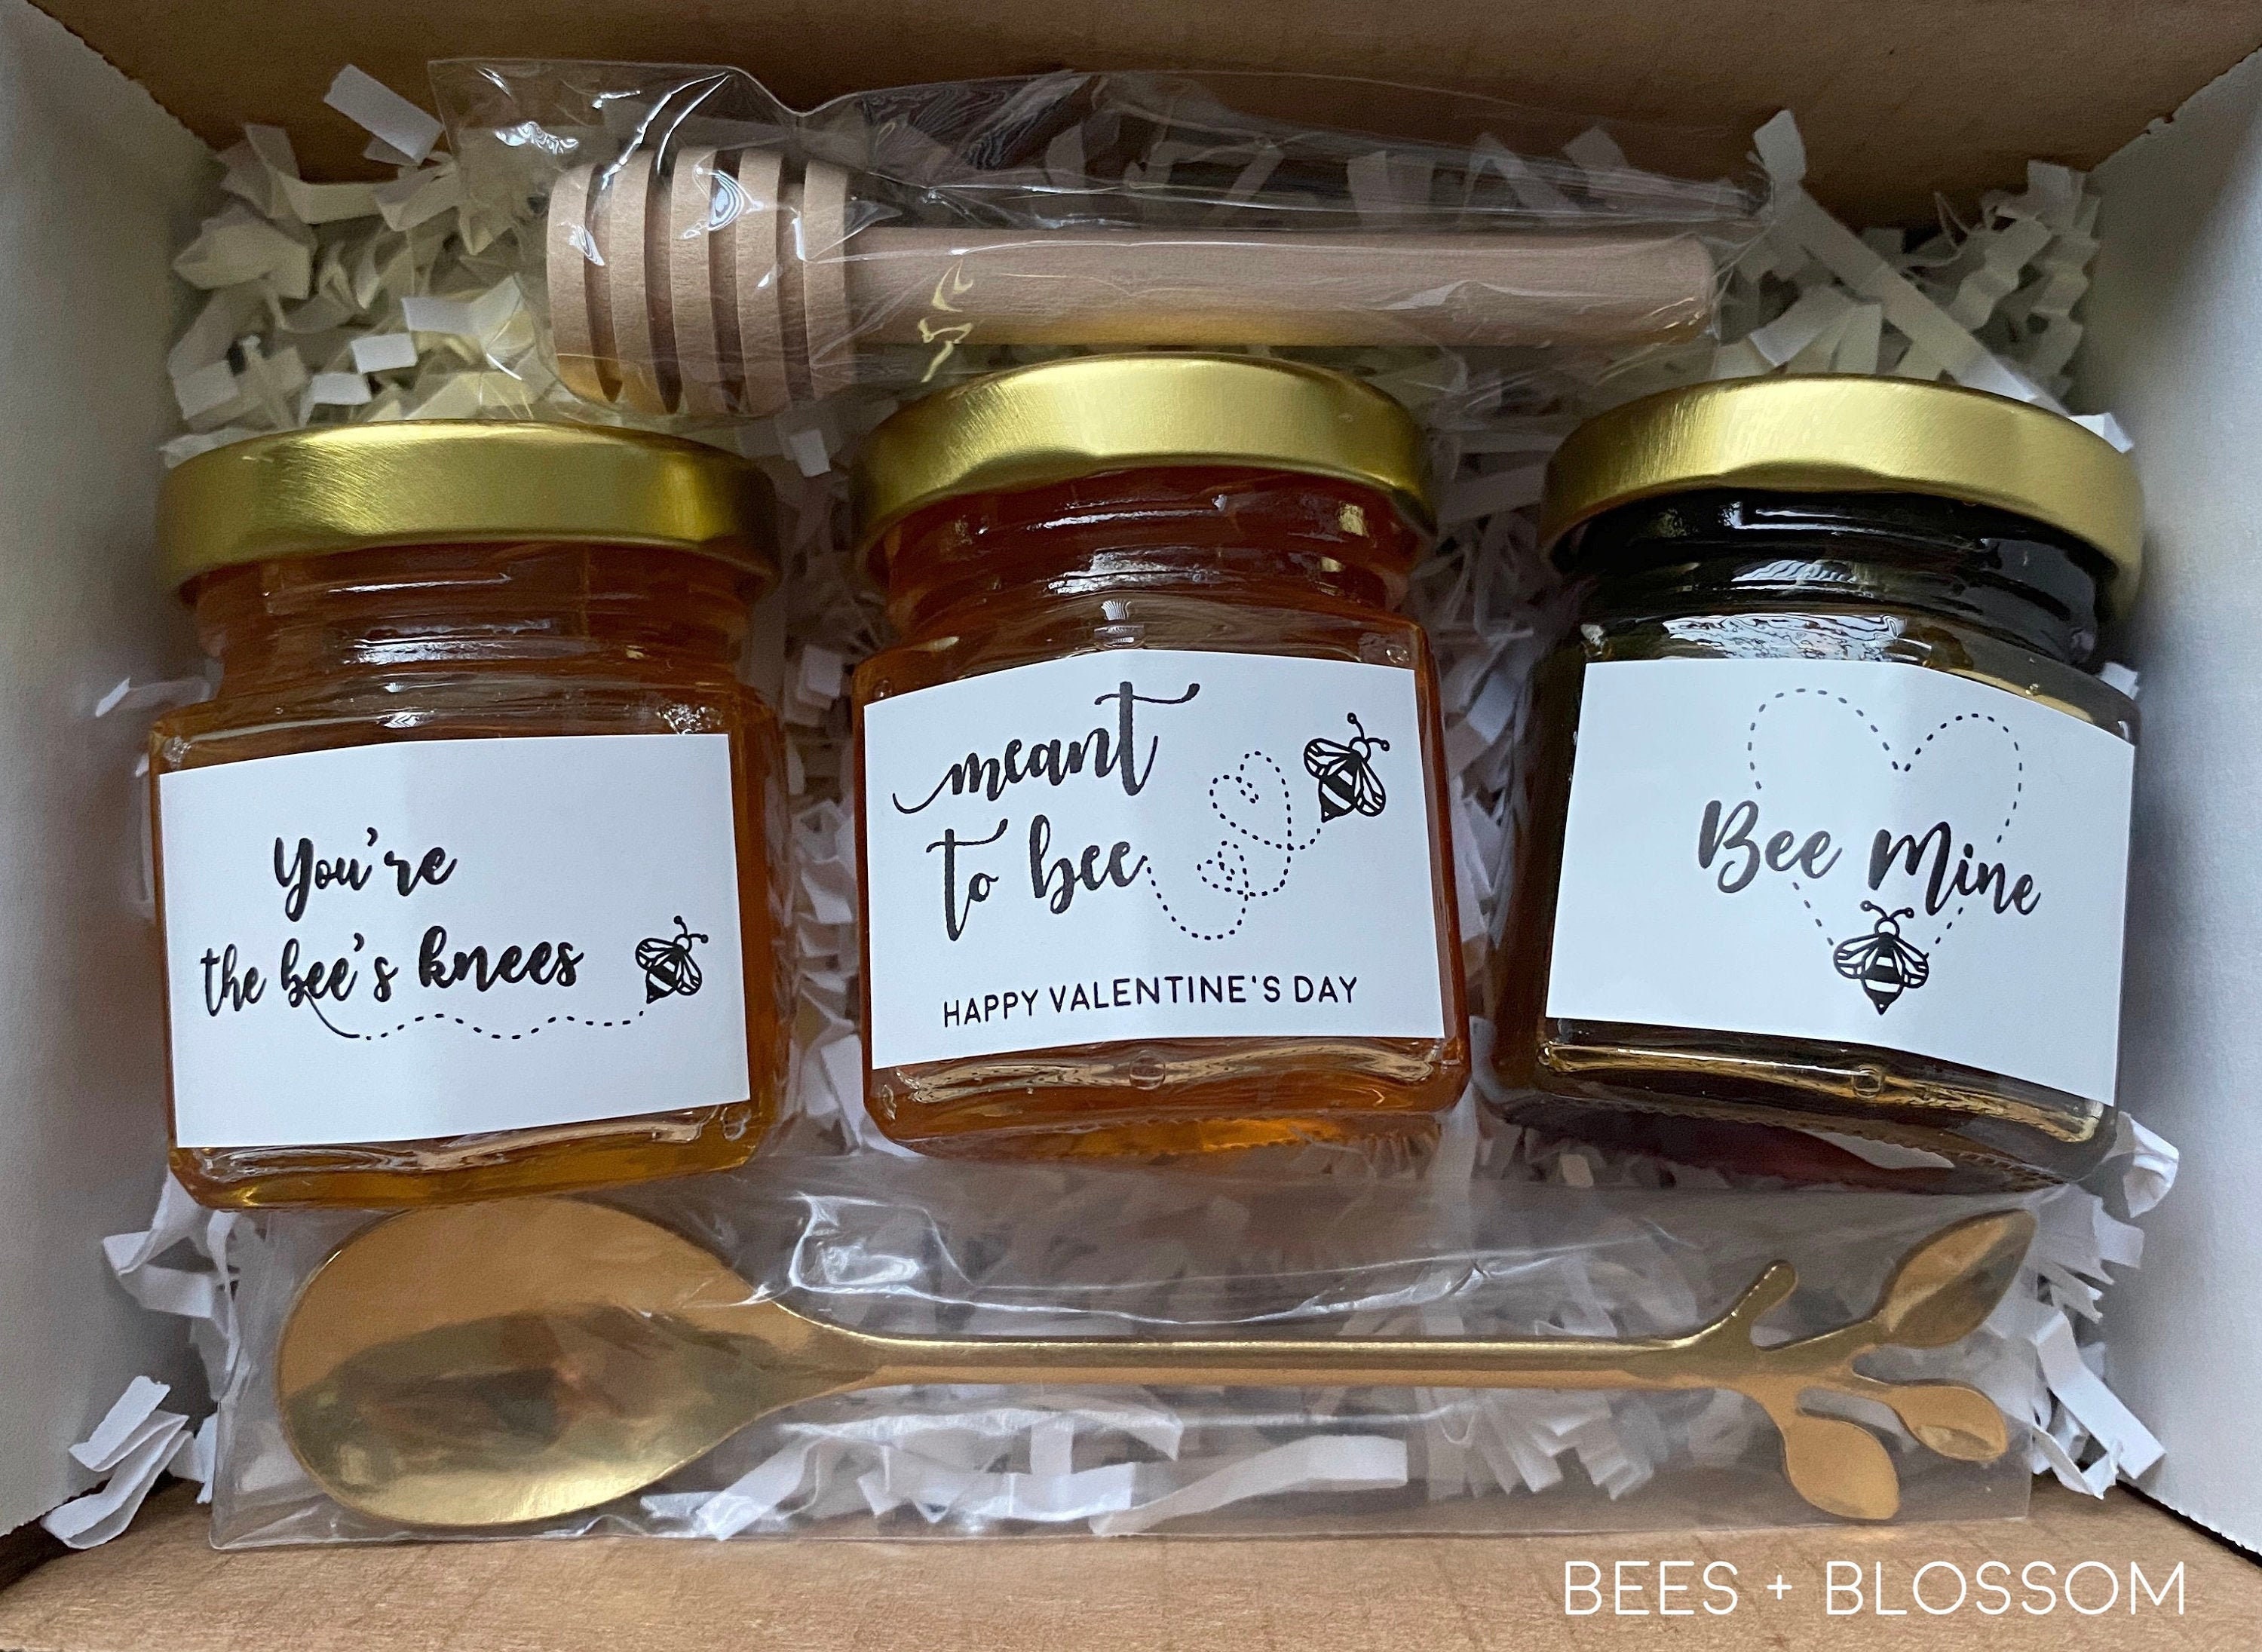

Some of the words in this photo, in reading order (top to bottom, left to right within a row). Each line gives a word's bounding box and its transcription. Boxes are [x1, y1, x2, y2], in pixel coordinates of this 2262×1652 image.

[892, 681, 1200, 814] meant
[274, 826, 458, 923] You're
[925, 818, 1009, 942] to
[1028, 814, 1148, 915] bee
[1698, 800, 1842, 893] Bee
[1868, 821, 2041, 917] Mine
[200, 943, 267, 1017] the
[280, 933, 399, 1009] bee's
[418, 925, 584, 992] knees
[943, 988, 1038, 1028] HAPPY
[1049, 975, 1280, 1013] VALENTINE'S
[1294, 975, 1358, 1005] DAY
